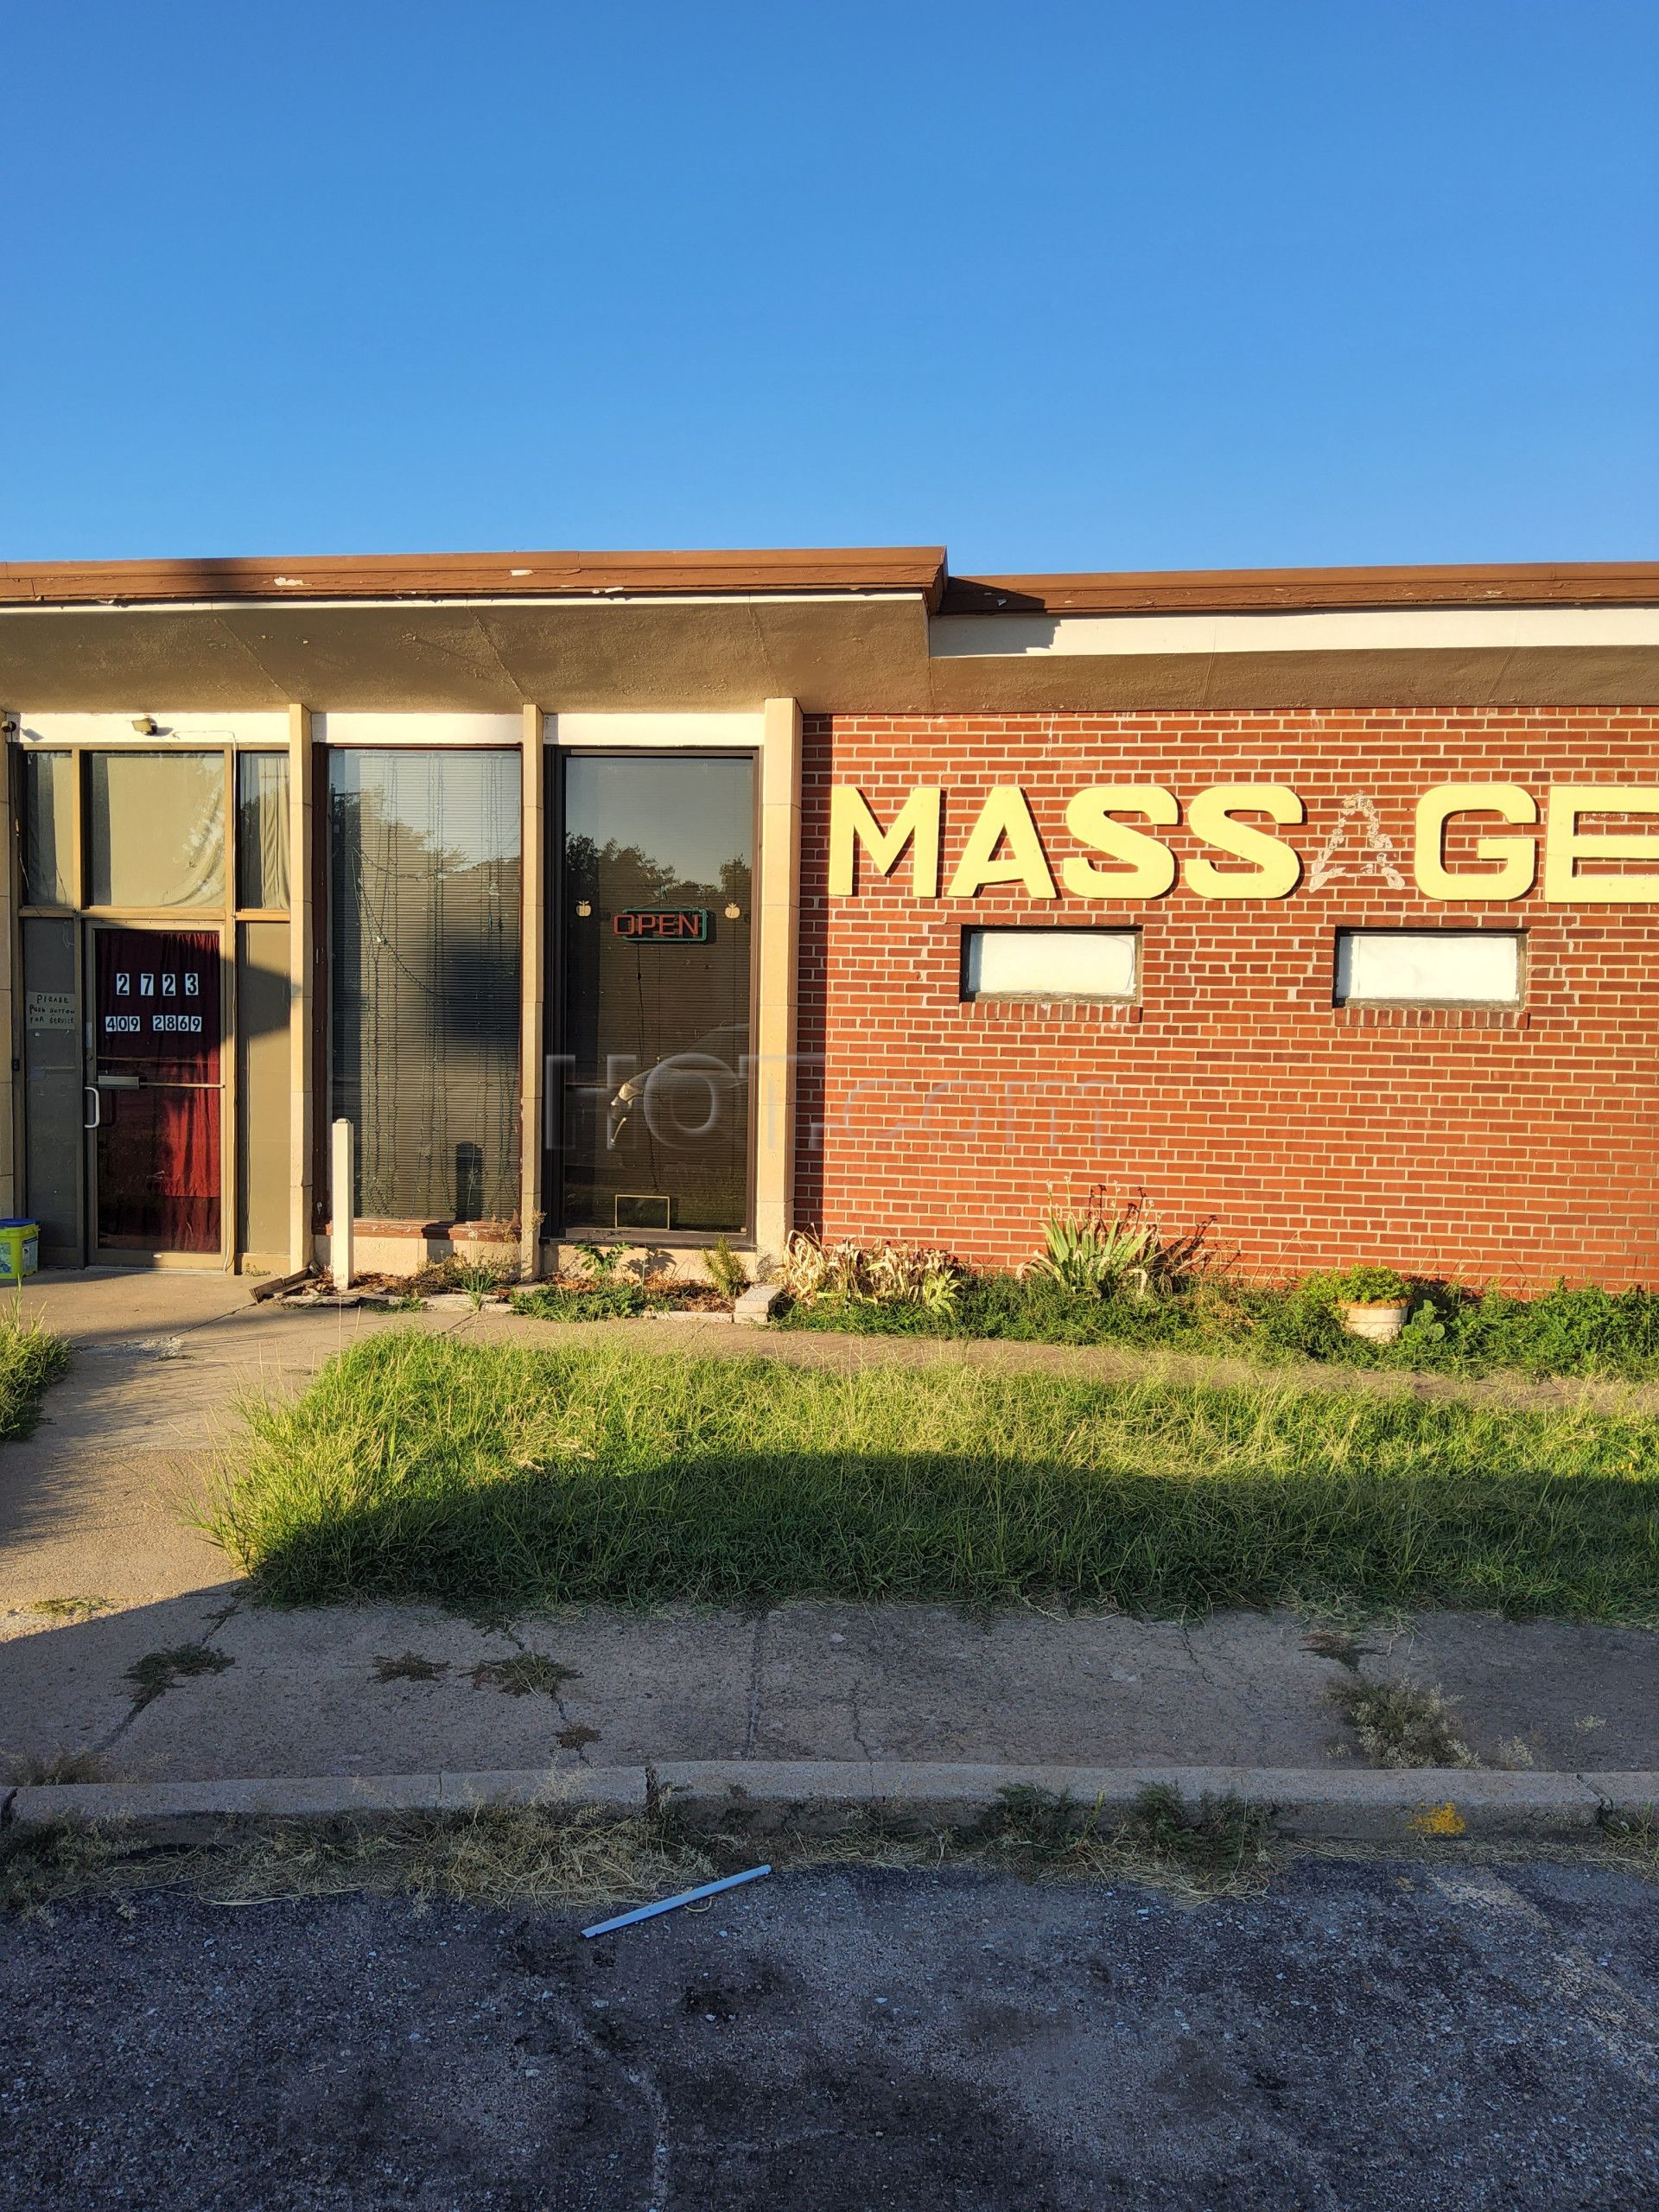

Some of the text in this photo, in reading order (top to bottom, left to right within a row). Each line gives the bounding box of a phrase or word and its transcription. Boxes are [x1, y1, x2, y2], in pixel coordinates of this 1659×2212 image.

[827, 783, 1659, 904] MASSAGE
[613, 913, 700, 937] OPEN
[118, 974, 198, 995] 2723
[106, 1016, 201, 1031] 409 2869
